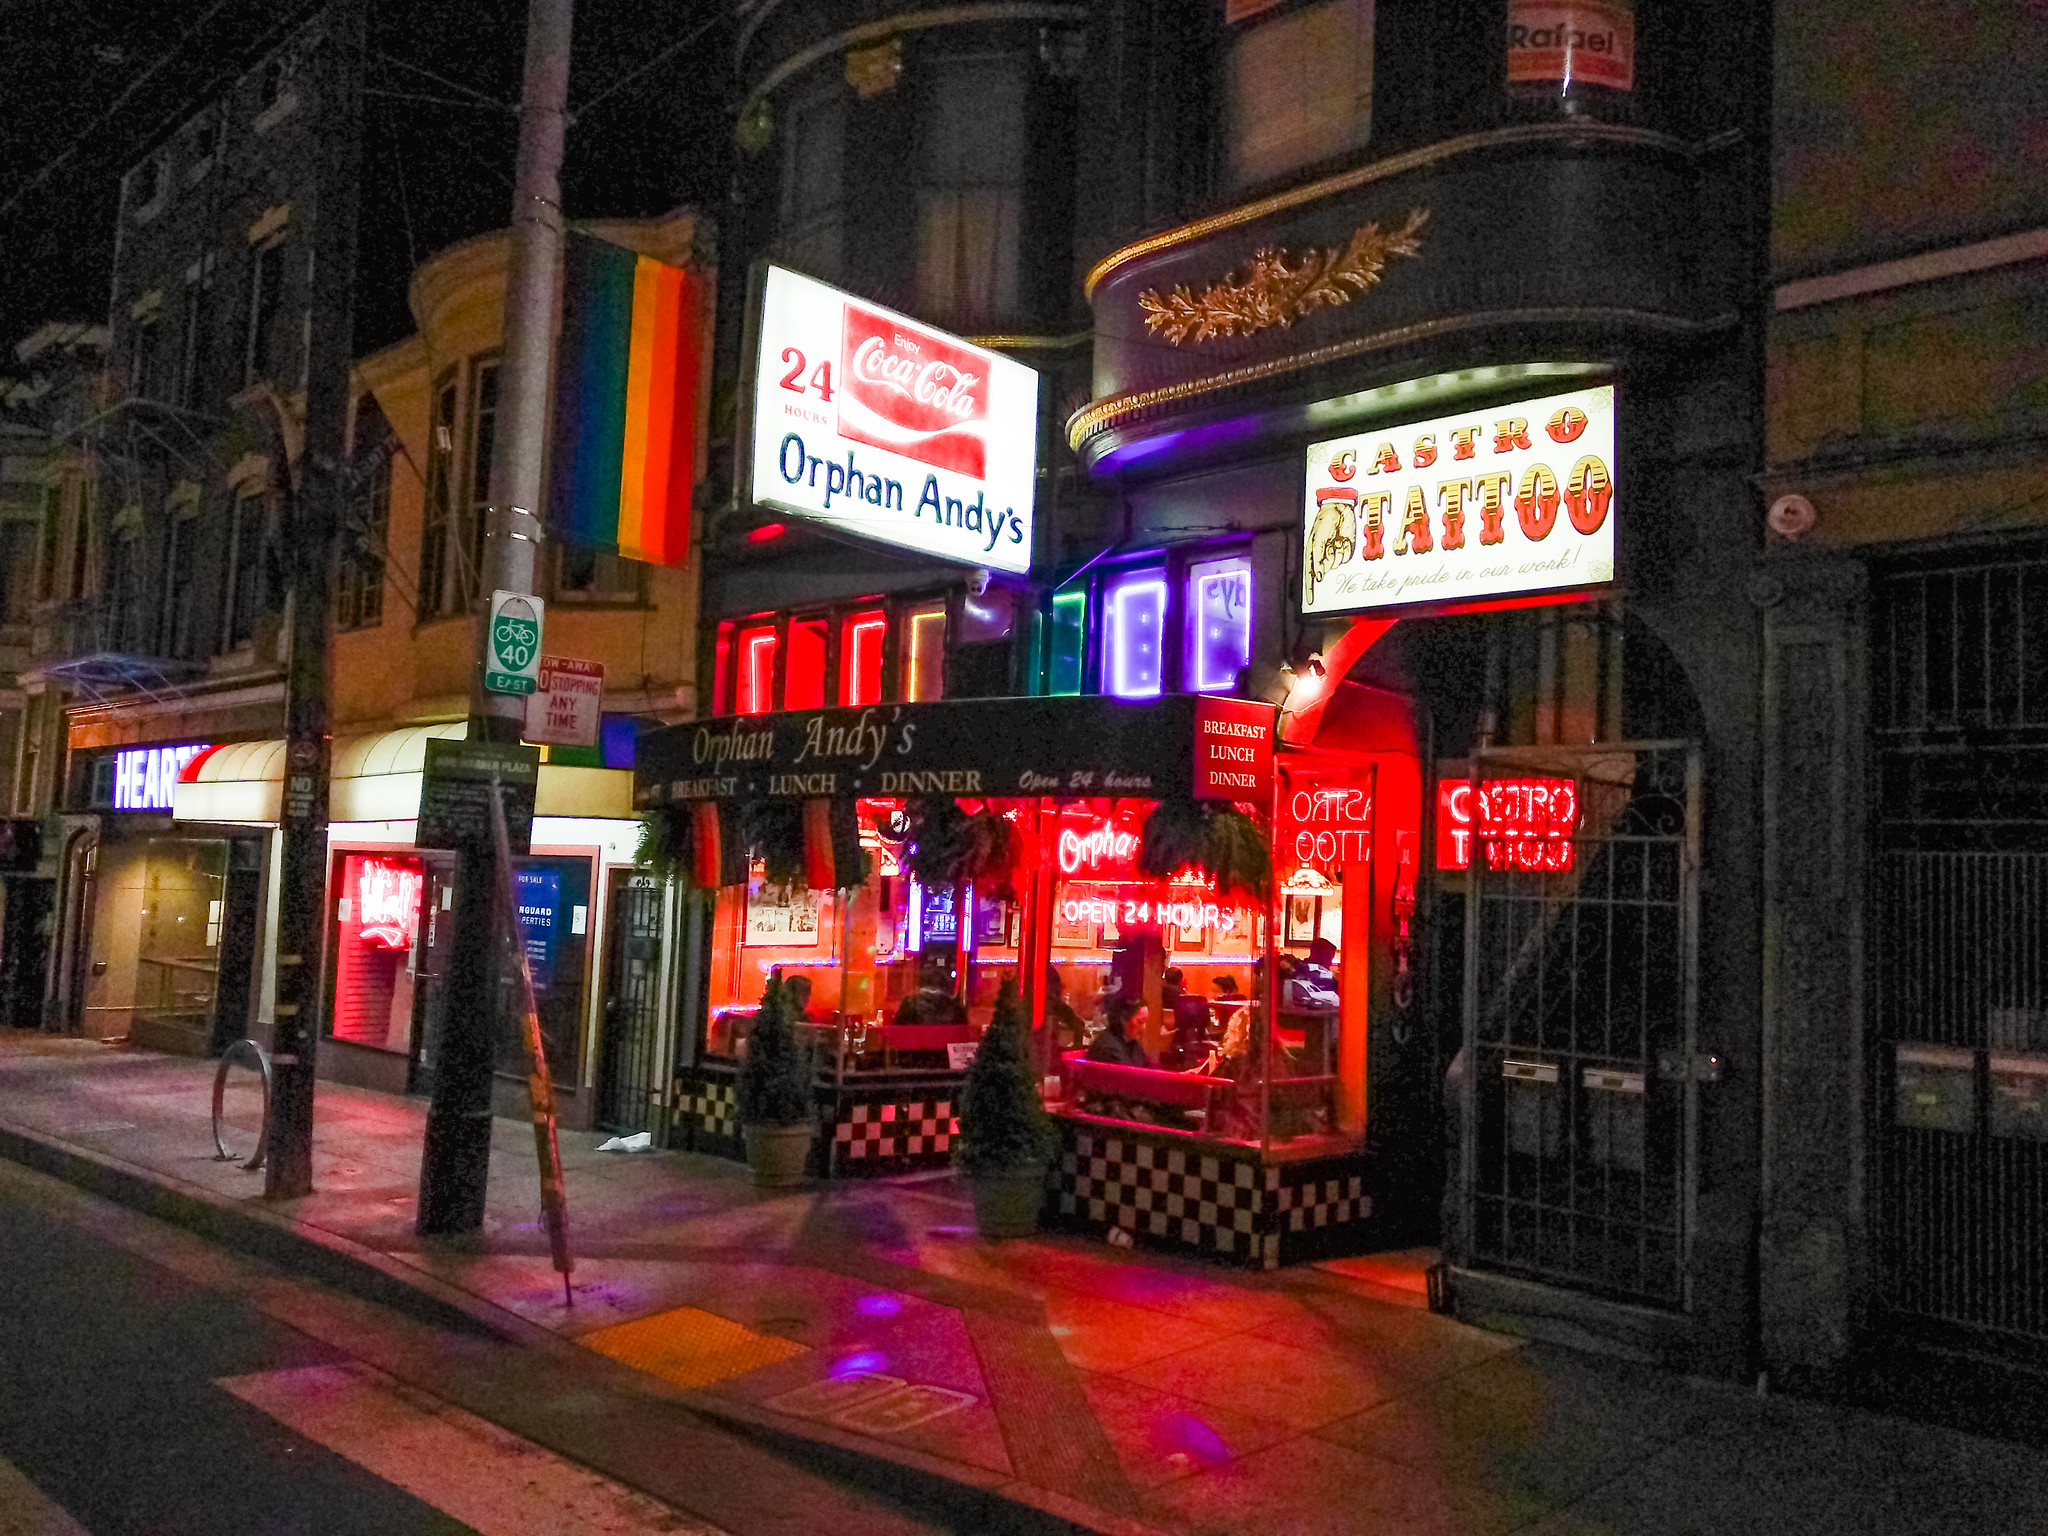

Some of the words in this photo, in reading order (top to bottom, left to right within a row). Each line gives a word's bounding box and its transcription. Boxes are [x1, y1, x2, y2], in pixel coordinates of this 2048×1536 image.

[894, 332, 921, 354] Enjoy
[779, 346, 835, 403] 24
[852, 336, 982, 418] Coca-Cola
[784, 404, 828, 426] HOURS
[1328, 406, 1588, 482] CASTRO
[779, 432, 903, 512] Orphan
[913, 473, 1024, 551] Andy's
[1358, 454, 1613, 562] TATTOO
[1335, 572, 1356, 595] We
[1362, 572, 1396, 593] take
[1395, 564, 1451, 597] pride
[1456, 567, 1474, 581] in
[1479, 563, 1511, 580] our
[1519, 543, 1583, 574] work!
[500, 645, 528, 666] 40
[540, 657, 598, 673] OW-AWAY
[496, 676, 528, 691] EAST
[539, 669, 551, 690] O
[552, 676, 599, 696] STOPPING
[549, 695, 577, 711] ANY
[546, 712, 577, 729] TIME
[1203, 720, 1266, 740] BREAKFAST
[693, 717, 775, 775] Orphan
[794, 706, 916, 770] Andy's
[1210, 745, 1255, 763] LUNCH
[115, 744, 210, 809] HEART
[769, 773, 836, 795] LUNCH
[881, 770, 982, 794] DINNER
[1018, 769, 1059, 791] Open
[1069, 770, 1094, 788] 24
[1104, 770, 1152, 789] hours
[1209, 771, 1257, 788] DINNER
[530, 876, 543, 884] SALE
[518, 905, 552, 917] NGUARD
[521, 916, 551, 927] PERTIES
[1064, 901, 1116, 924] OPEN
[1124, 902, 1149, 924] 24
[1157, 903, 1236, 931] HOURS
